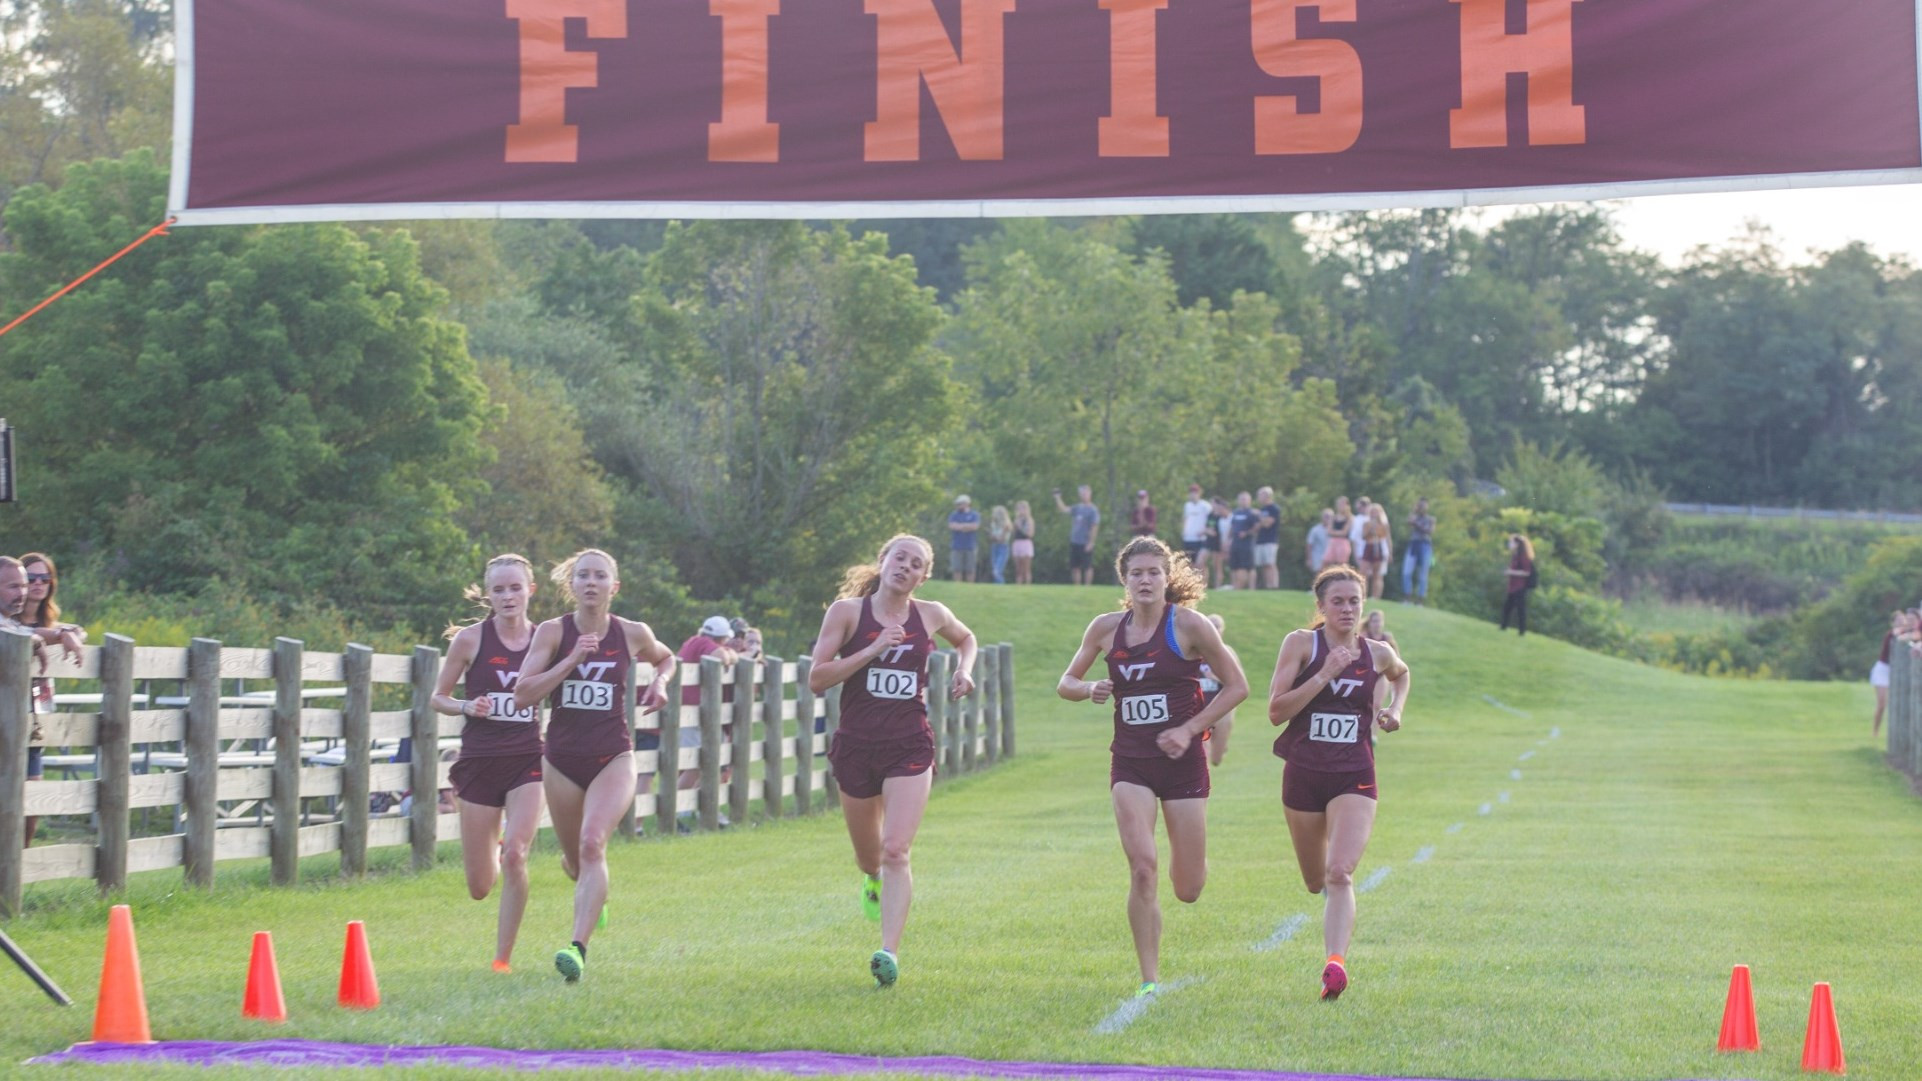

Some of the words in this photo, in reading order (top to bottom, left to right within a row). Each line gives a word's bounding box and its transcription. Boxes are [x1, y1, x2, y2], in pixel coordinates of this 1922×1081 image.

[505, 0, 1586, 163] FINISH
[496, 670, 520, 688] V
[577, 661, 617, 682] VT
[1118, 662, 1156, 681] VT
[870, 672, 914, 696] 102
[1328, 678, 1364, 697] VT
[564, 684, 609, 707] 103
[1124, 698, 1165, 722] 105
[1312, 717, 1356, 739] 107
